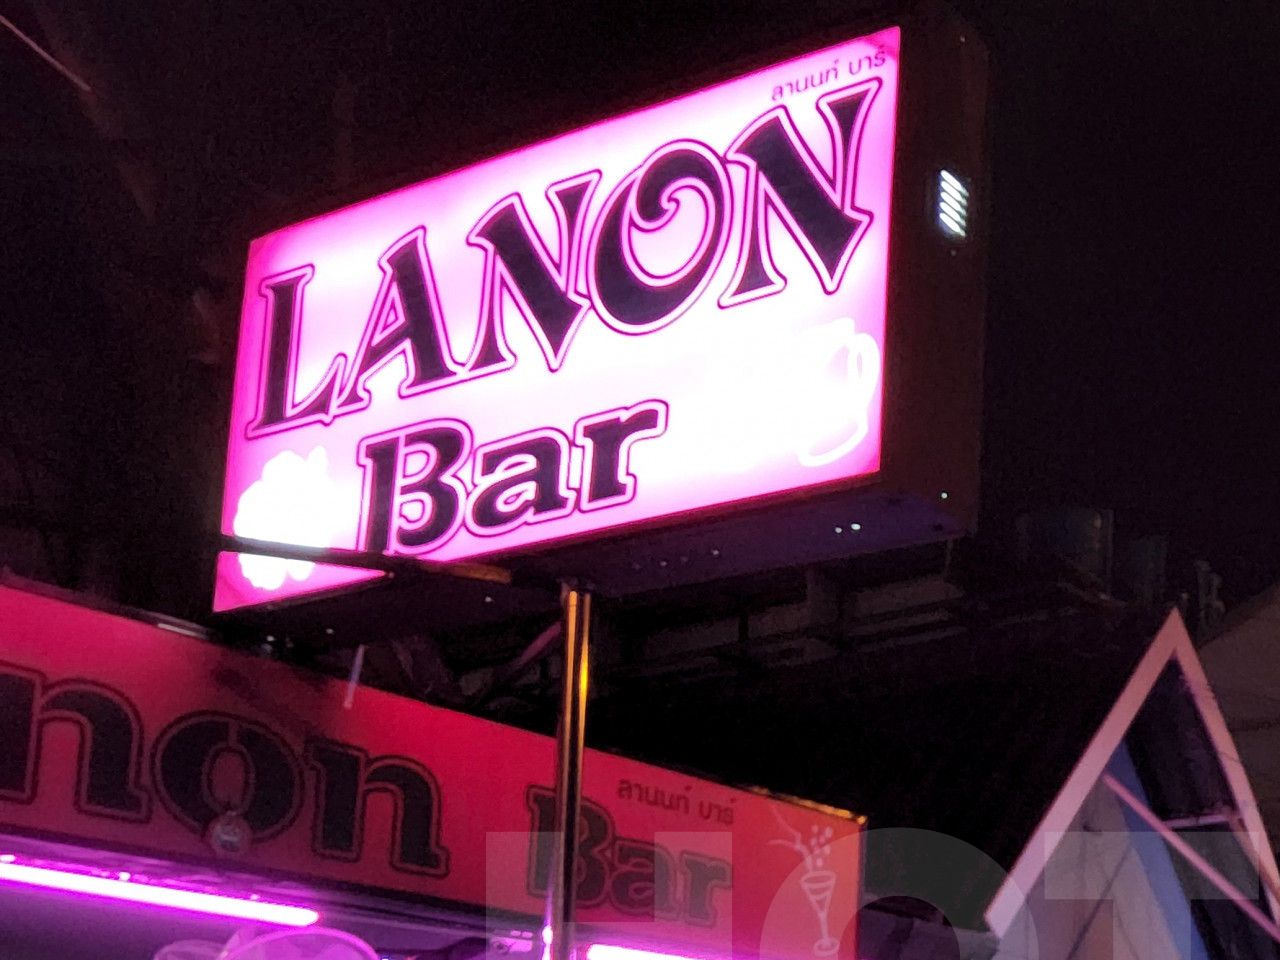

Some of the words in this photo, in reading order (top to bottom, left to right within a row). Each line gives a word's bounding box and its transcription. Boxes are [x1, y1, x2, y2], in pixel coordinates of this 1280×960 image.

[246, 76, 882, 438] LANON
[356, 398, 669, 556] Bar
[524, 783, 733, 929] Bar
